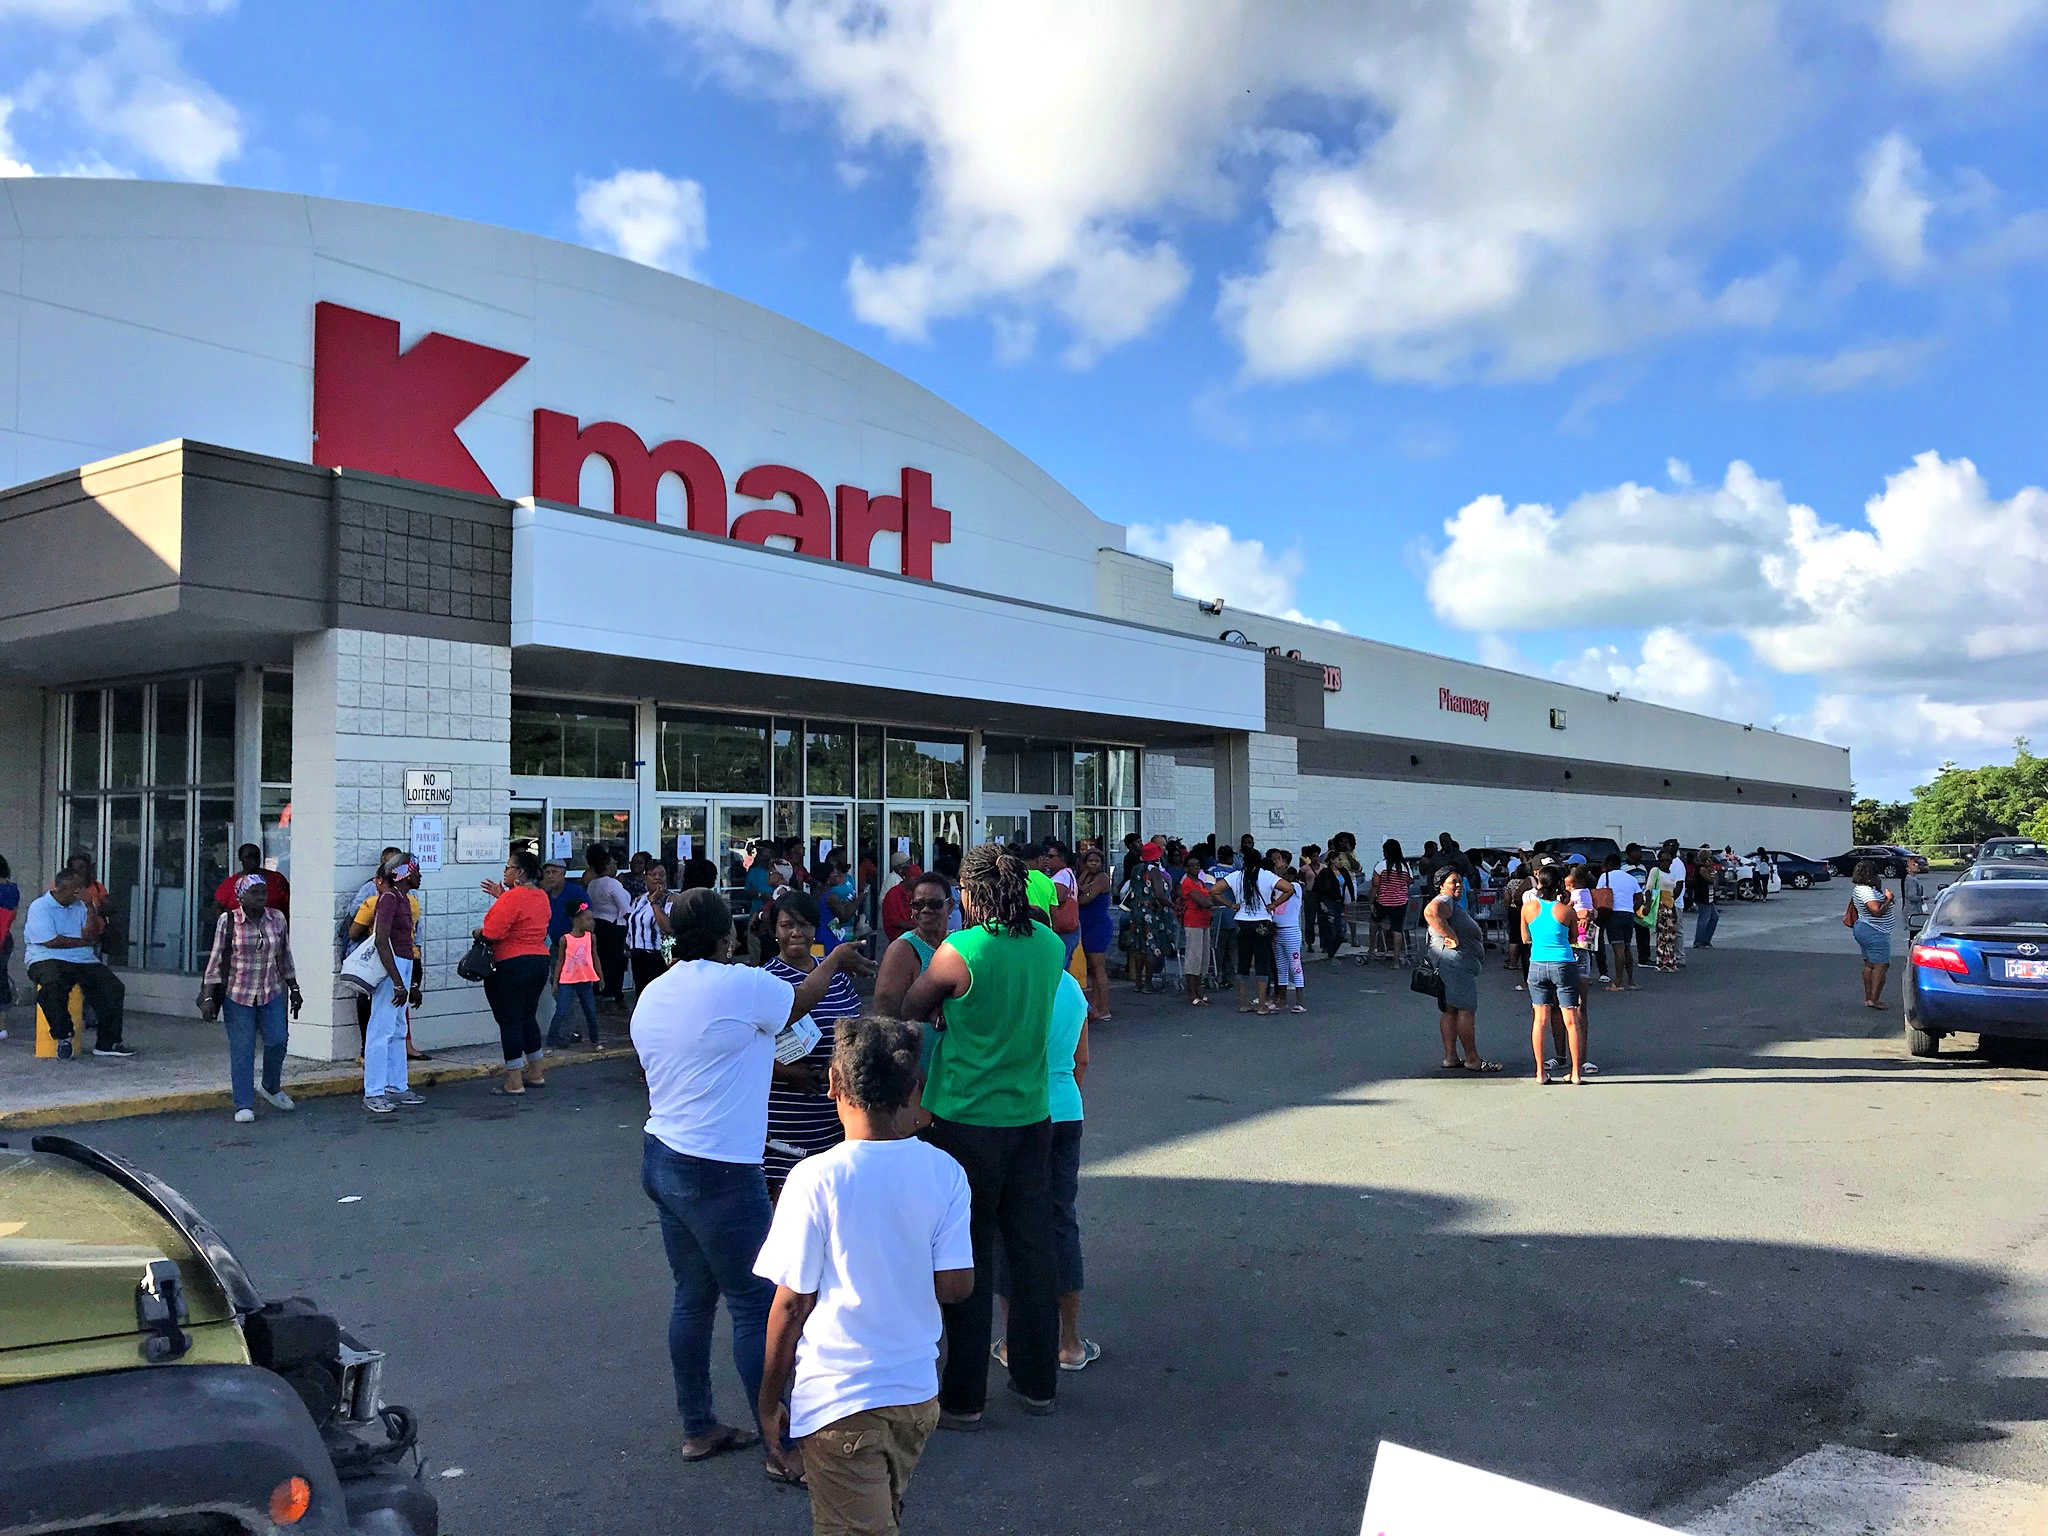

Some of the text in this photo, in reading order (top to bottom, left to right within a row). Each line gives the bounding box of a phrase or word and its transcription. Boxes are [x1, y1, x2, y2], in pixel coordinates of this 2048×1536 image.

[312, 299, 951, 581] Kmart
[1439, 687, 1490, 722] Pharmacy
[423, 773, 436, 786] NO
[407, 788, 451, 801] LOITERING
[423, 822, 431, 831] NO
[415, 833, 440, 842] PARKING
[418, 845, 436, 853] FIRE
